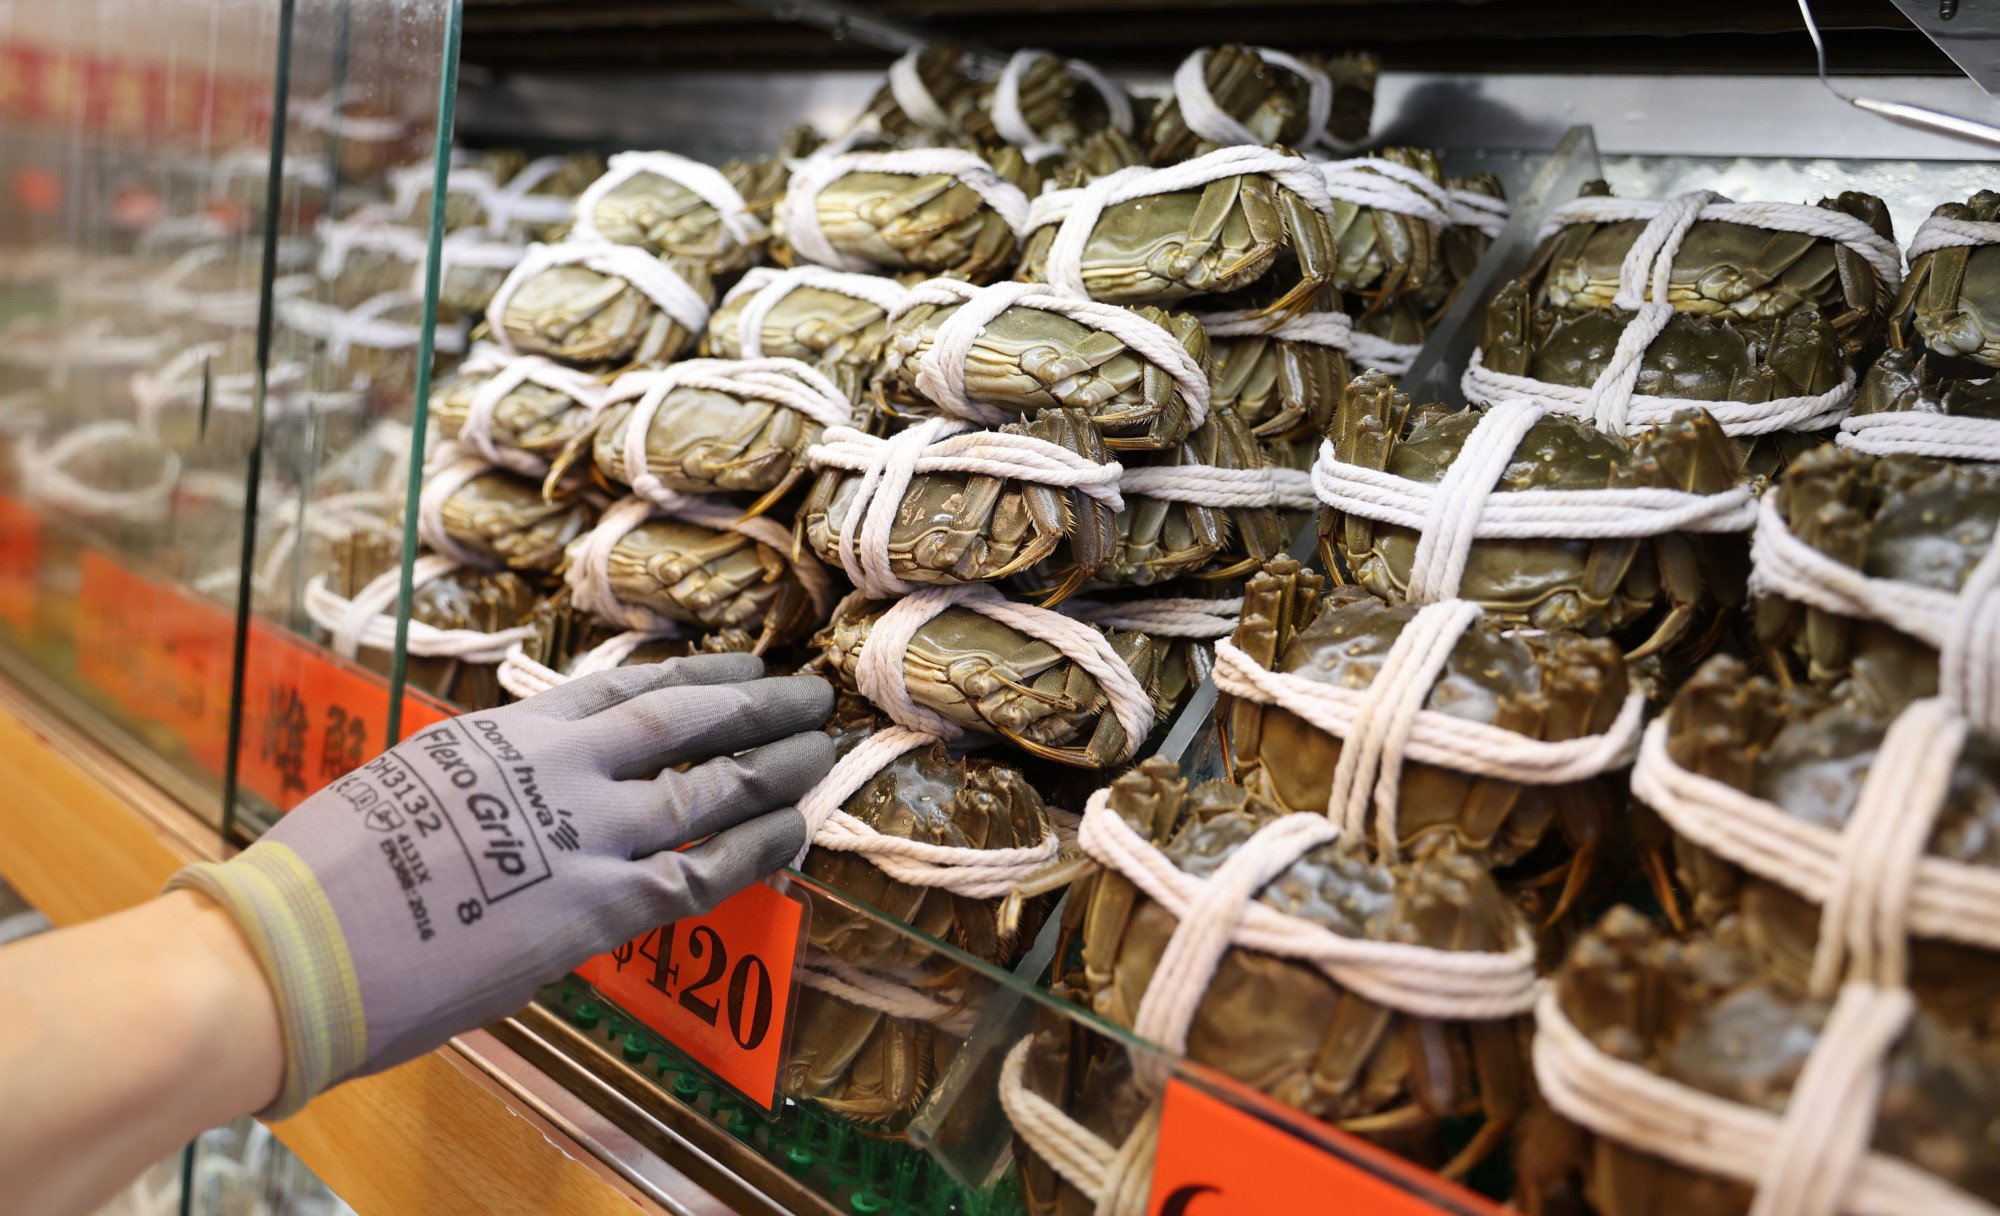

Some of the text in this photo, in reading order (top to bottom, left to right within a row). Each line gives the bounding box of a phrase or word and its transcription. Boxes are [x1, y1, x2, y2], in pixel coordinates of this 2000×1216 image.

[364, 757, 442, 838] DH3132
[416, 727, 526, 876] Flexo Grip
[473, 718, 554, 827] Dong hwa
[397, 833, 433, 883] 4131X
[457, 898, 483, 926] 8
